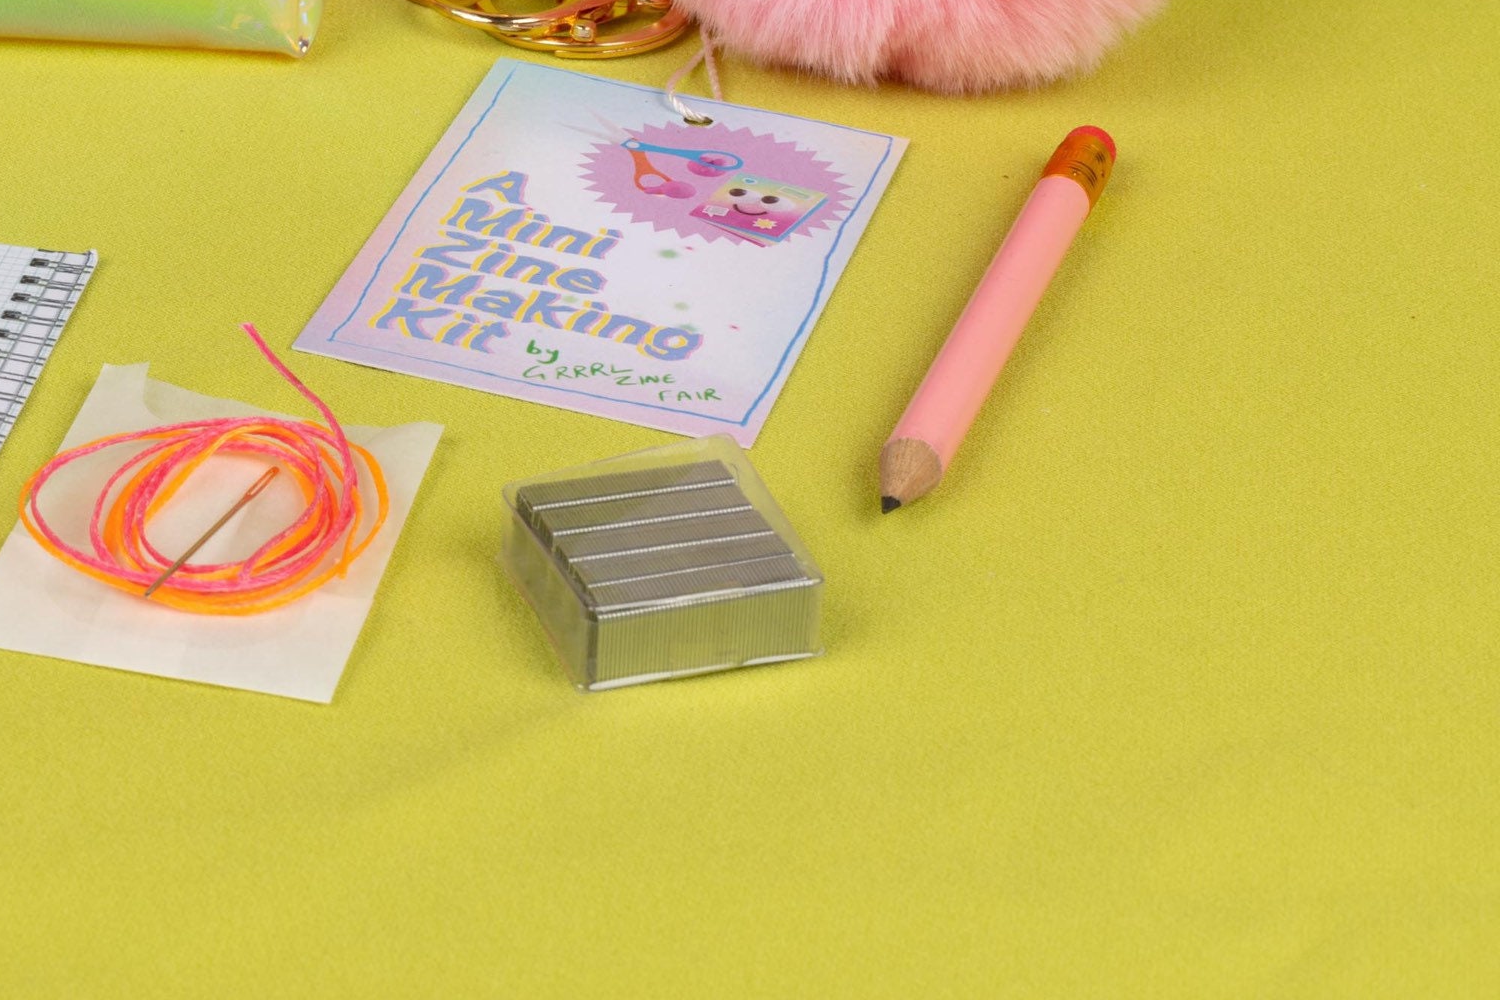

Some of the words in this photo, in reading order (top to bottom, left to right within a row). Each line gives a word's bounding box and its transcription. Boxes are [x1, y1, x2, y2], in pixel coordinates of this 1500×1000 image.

[459, 170, 530, 205] A
[439, 196, 624, 260] Mini
[413, 230, 609, 295] Zine
[368, 297, 512, 354] Kit
[393, 262, 704, 362] Making
[522, 362, 634, 380] GRRRL
[614, 373, 676, 386] ZINE
[526, 340, 559, 364] by
[658, 387, 722, 402] FAIR
